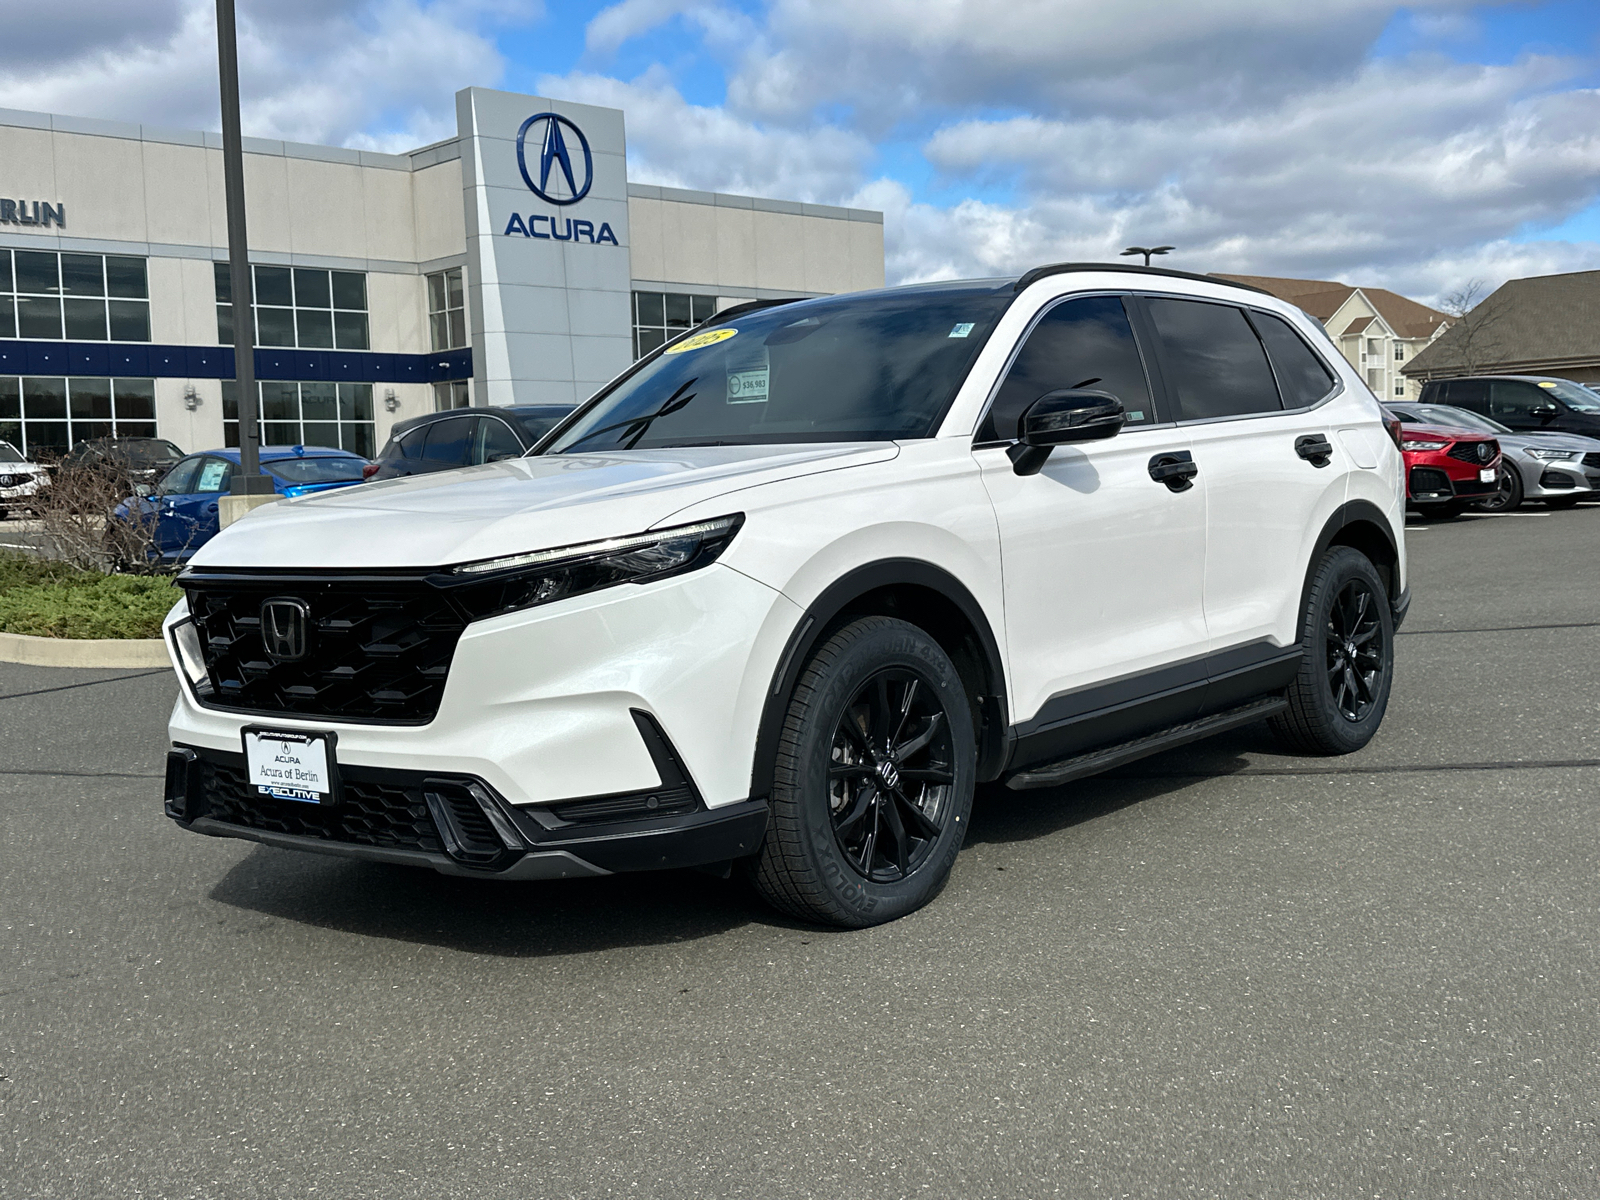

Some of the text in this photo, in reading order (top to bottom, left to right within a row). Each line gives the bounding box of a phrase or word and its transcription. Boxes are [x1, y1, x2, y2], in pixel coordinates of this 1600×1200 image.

[0, 199, 64, 225] RLIN
[504, 212, 619, 246] ACURA
[274, 755, 301, 764] ACURA
[260, 765, 319, 782] Acura of Berlin
[258, 786, 320, 801] EXECUTIVE
